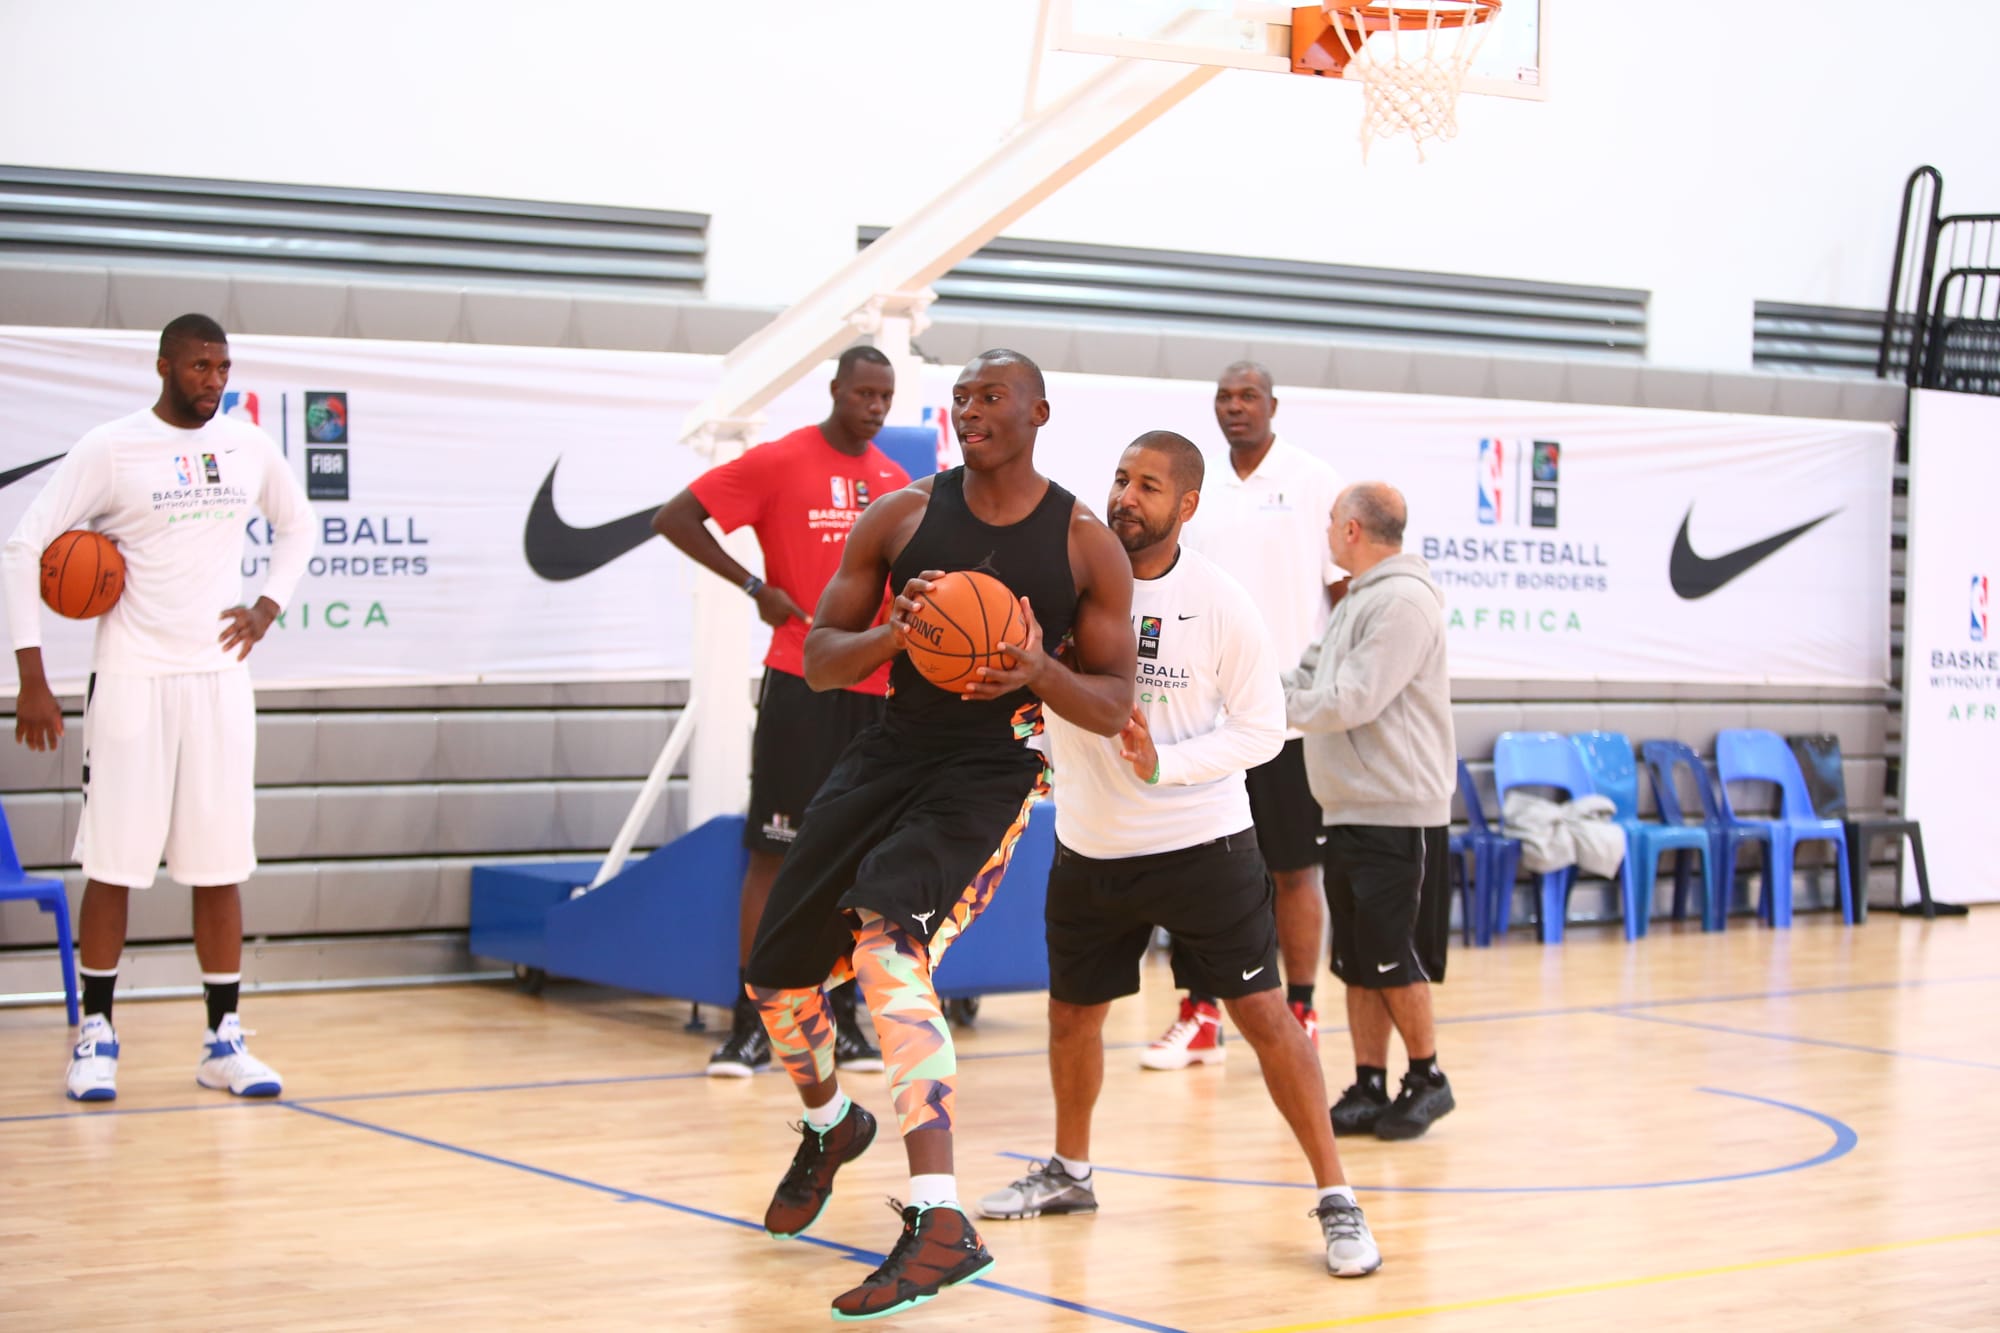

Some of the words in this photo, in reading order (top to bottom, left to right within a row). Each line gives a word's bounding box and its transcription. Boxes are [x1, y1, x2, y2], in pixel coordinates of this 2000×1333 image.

[311, 453, 344, 474] FIBA
[152, 487, 247, 501] BASKETBALL
[808, 509, 864, 521] BASKET
[1422, 537, 1608, 567] BASKETBALL
[308, 556, 428, 577] ORDERS
[1516, 573, 1607, 592] BORDERS
[1448, 608, 1582, 632] AFRICA
[909, 615, 944, 647] DING
[1136, 675, 1188, 689] ORDERS
[1930, 676, 1992, 689] WITHOUT
